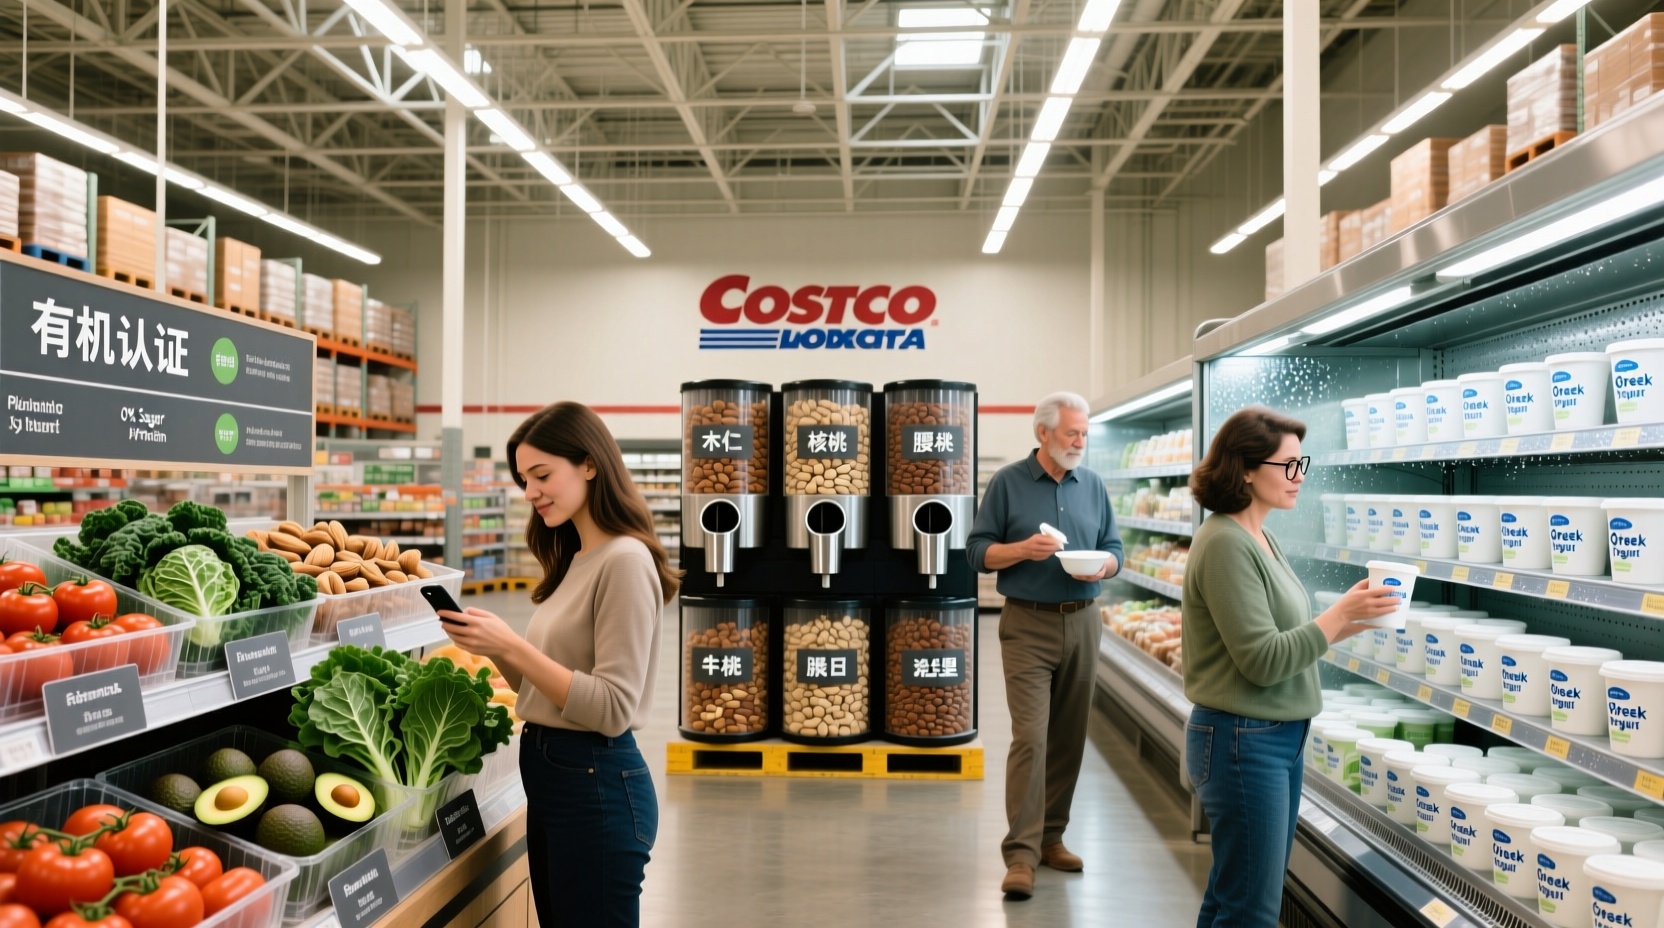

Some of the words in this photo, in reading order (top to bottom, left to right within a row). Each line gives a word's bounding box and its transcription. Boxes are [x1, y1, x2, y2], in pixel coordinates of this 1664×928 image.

[699, 274, 937, 325] COSTCO
[31, 297, 189, 377] 有机认证
[121, 406, 136, 423] 0%
[701, 430, 743, 453] 木仁
[807, 430, 848, 453] 核桃
[701, 654, 742, 677] 牛桃
